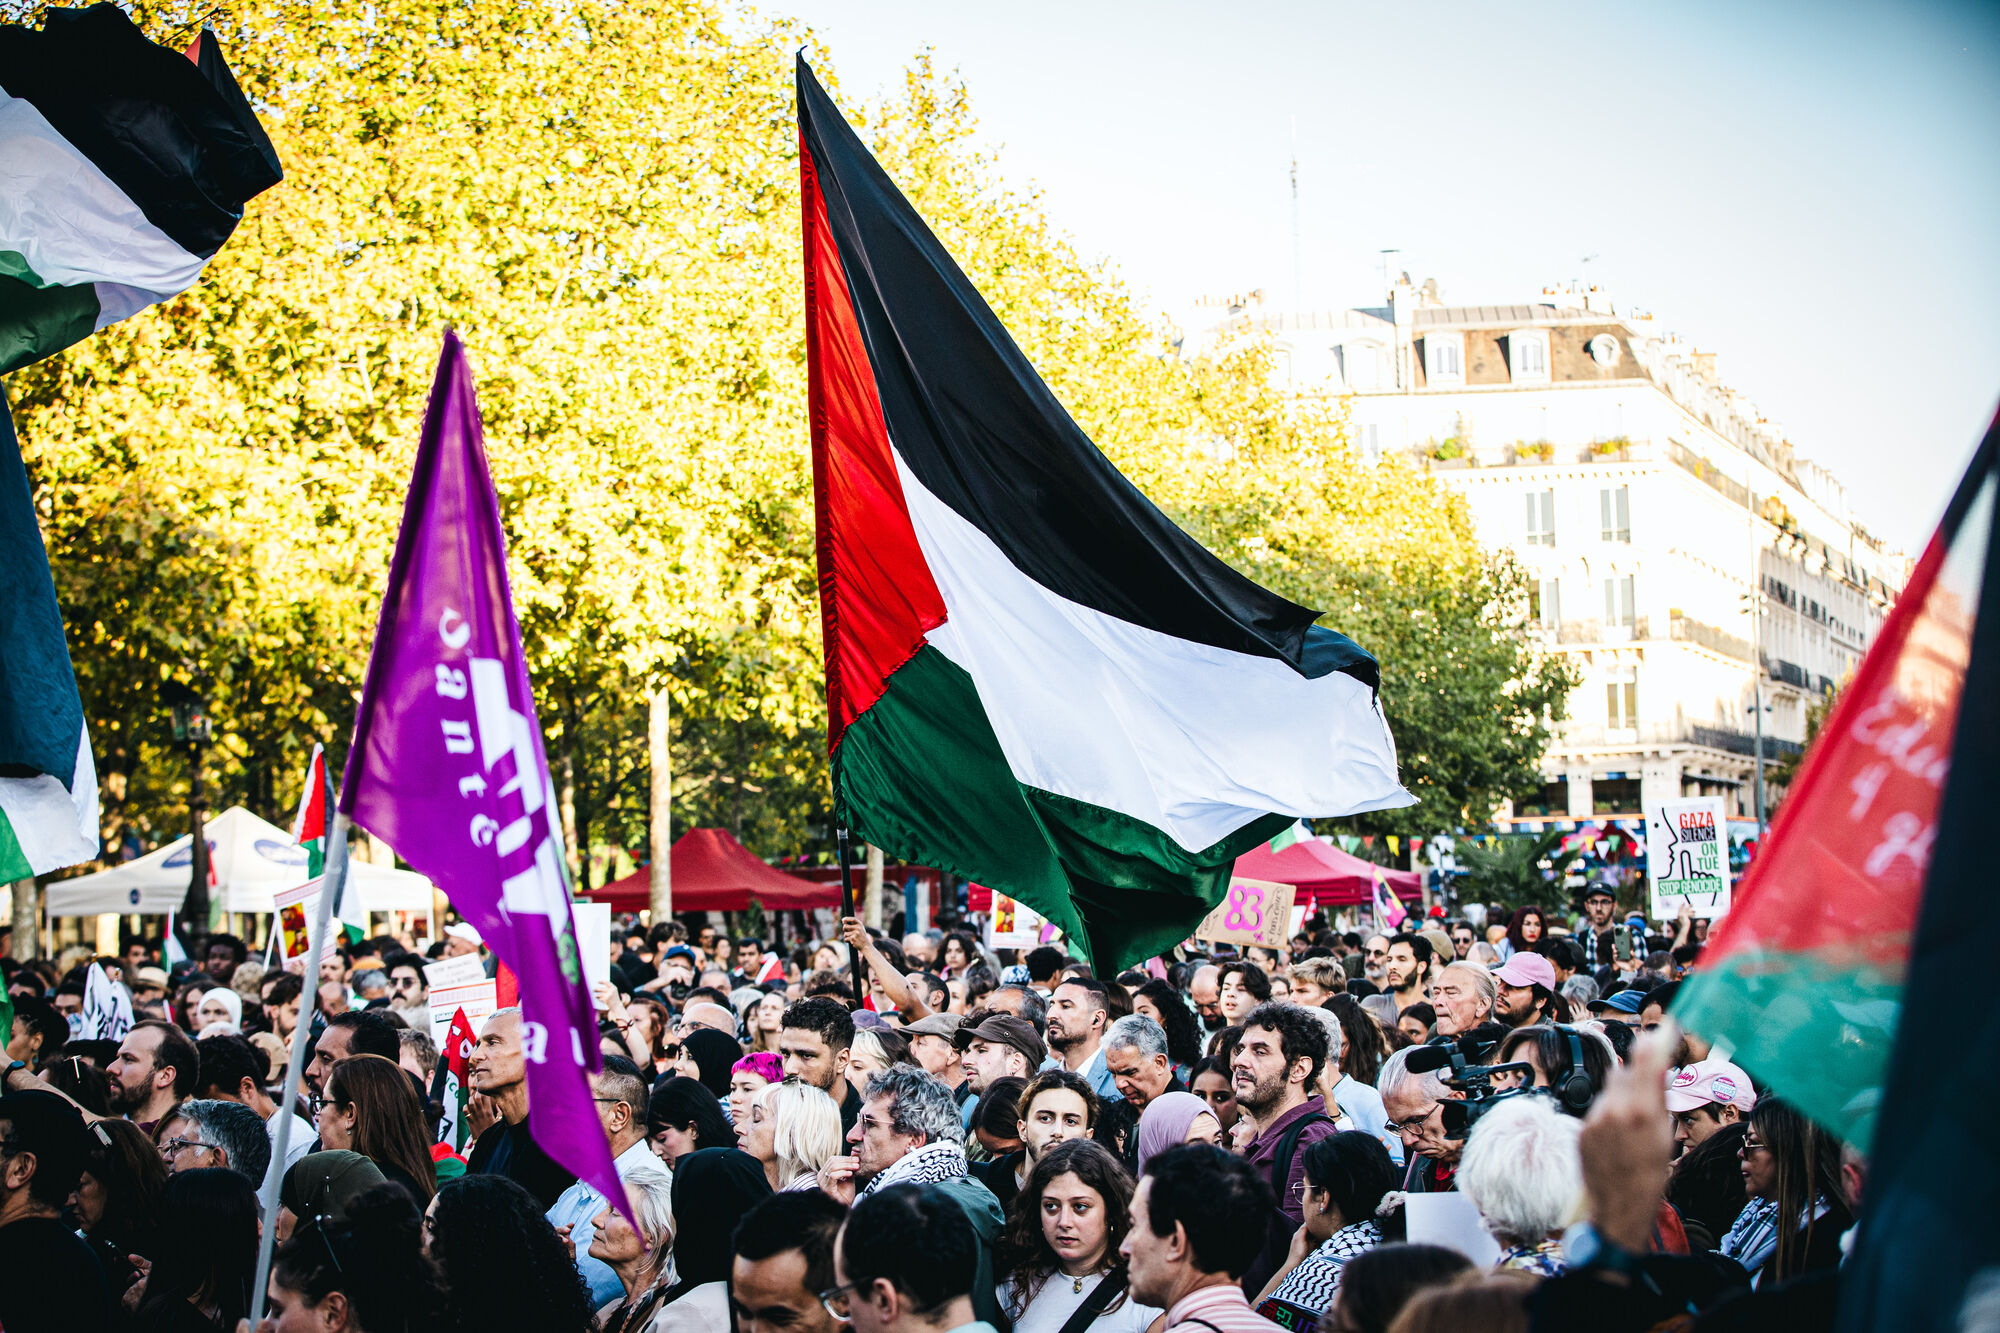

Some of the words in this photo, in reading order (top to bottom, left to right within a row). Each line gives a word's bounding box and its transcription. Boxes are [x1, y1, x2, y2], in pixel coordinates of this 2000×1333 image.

[1680, 811, 1715, 829] GAZA
[1681, 827, 1716, 842] SILENCE
[1701, 842, 1719, 856] ON
[1696, 856, 1720, 870] TUE
[1659, 881, 1680, 896] STOP
[1681, 878, 1722, 894] GENOCIDE
[1224, 885, 1265, 931] 83
